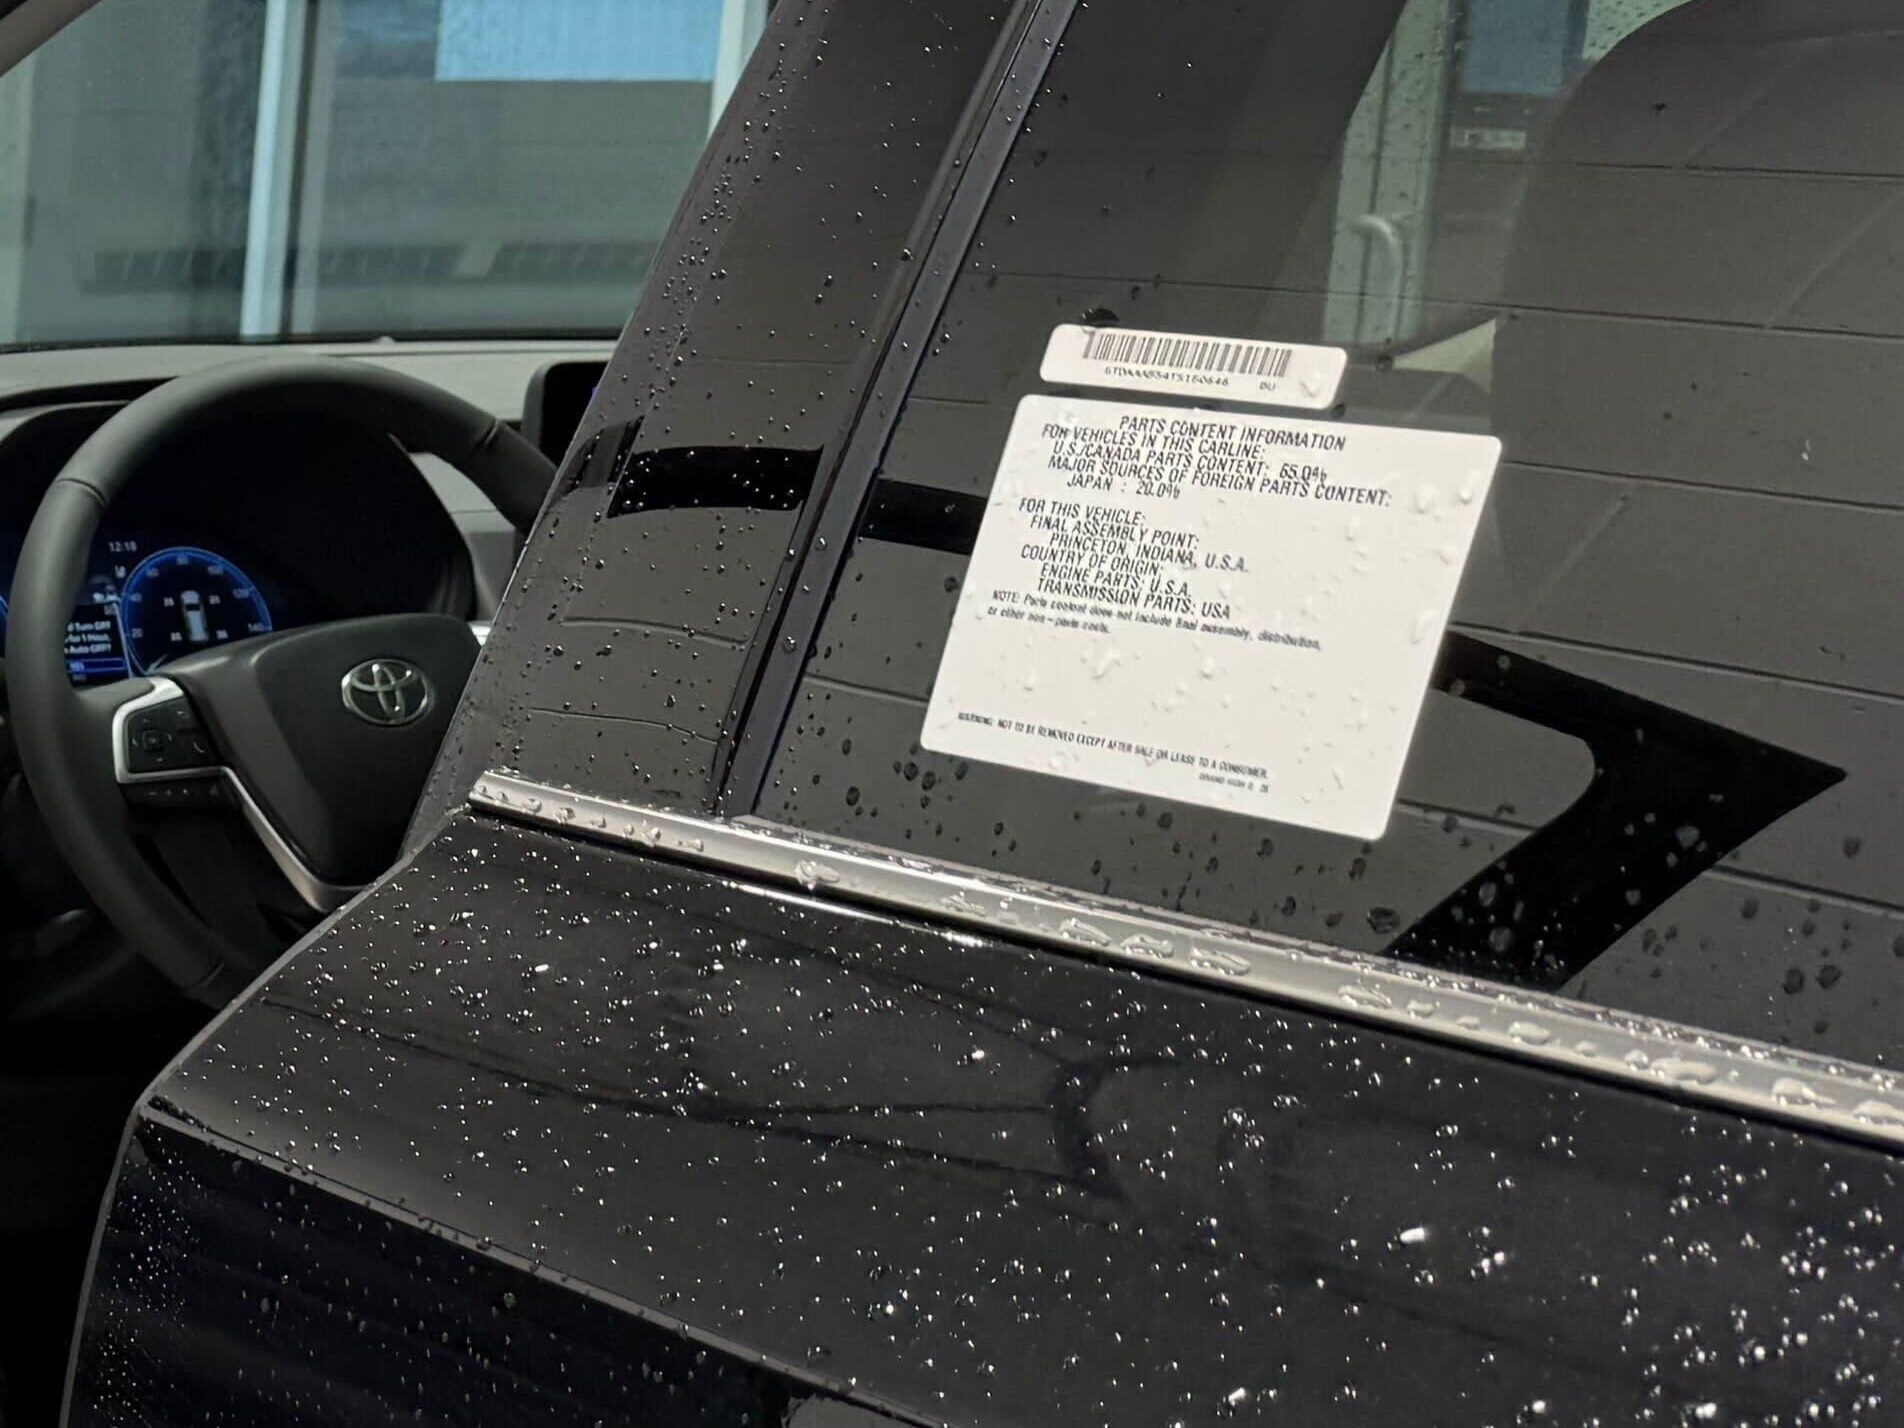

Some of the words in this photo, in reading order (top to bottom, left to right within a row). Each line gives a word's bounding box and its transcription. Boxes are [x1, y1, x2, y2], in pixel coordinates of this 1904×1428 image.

[1041, 423, 1068, 439] FOR
[1073, 426, 1138, 447] VEHICLES
[1141, 434, 1156, 448] IN
[1163, 436, 1193, 453] THIS
[1198, 439, 1265, 459] CARLINE:
[1120, 415, 1166, 434] PARTS
[1170, 419, 1237, 440] CONTENT
[1242, 426, 1346, 451] INFORMATION
[1146, 450, 1193, 469] PARTS
[1197, 455, 1269, 477] CONTENT:
[1048, 455, 1096, 474] MAJOR
[1099, 460, 1165, 482] SOURCES
[1168, 468, 1189, 483] OF
[1192, 472, 1255, 491] FOREIGN
[1259, 478, 1309, 498] PARTS
[1314, 484, 1392, 507] CONTENT:
[1067, 474, 1114, 492] JAPAN
[1019, 498, 1046, 513] FOR
[1051, 501, 1080, 519] THIS
[1086, 505, 1146, 526] VEHICLE:
[1030, 515, 1068, 532] FINAL
[1072, 520, 1148, 541] ASSEMBLY
[1151, 530, 1200, 550] POINT:
[1021, 544, 1084, 563] COUNTRY
[1089, 554, 1108, 568] OF
[1110, 556, 1164, 576] ORIGIN:
[1205, 553, 1249, 572] U.S.A.
[1041, 562, 1089, 581] ENGINE
[1094, 571, 1146, 590] PARTS:
[1149, 576, 1192, 596] U.S.A.
[1037, 578, 1141, 607] TRANSMISSION
[1143, 594, 1196, 615] PARTS:
[1201, 602, 1231, 620] USA
[1117, 609, 1133, 621] not
[1176, 618, 1199, 632] final
[1038, 725, 1075, 742] REMOVED
[1108, 739, 1133, 753] AFTER
[1156, 748, 1168, 761] OR
[1170, 751, 1195, 765] LEASE
[1198, 756, 1209, 768] TO
